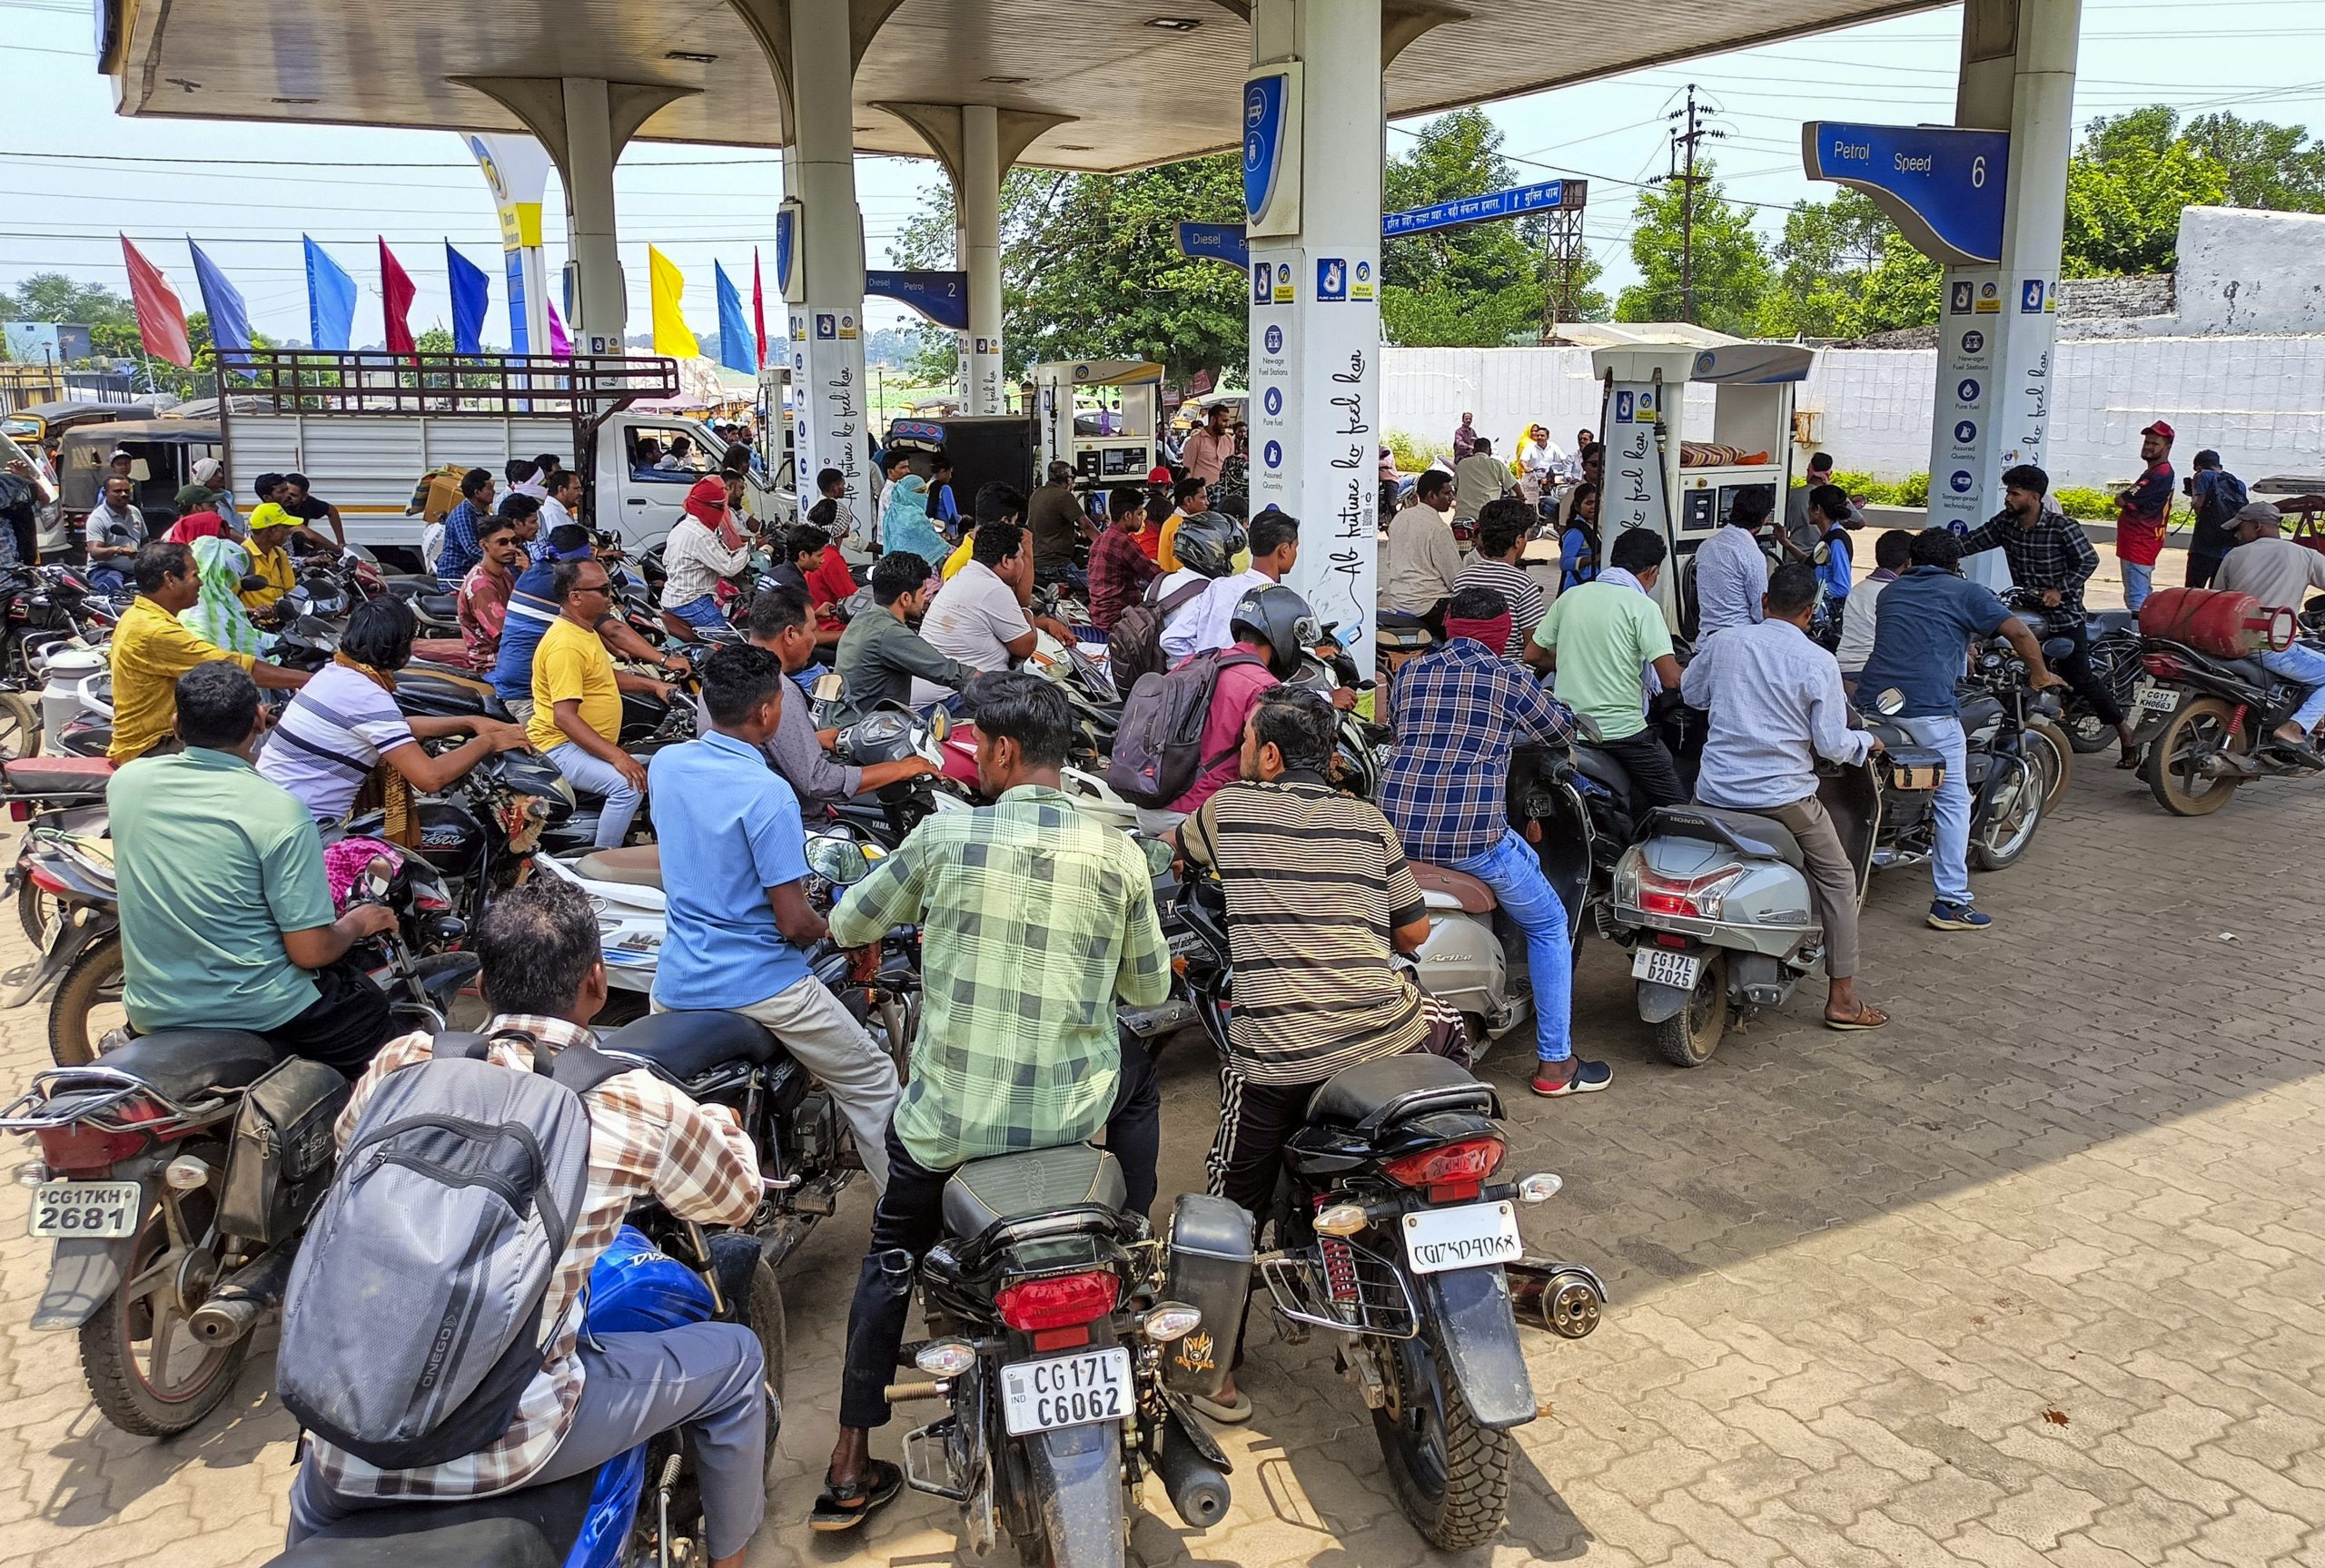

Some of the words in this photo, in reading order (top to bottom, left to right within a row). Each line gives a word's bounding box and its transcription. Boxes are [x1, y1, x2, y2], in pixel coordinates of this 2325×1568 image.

[1834, 140, 1870, 160] Petrol
[1894, 153, 1932, 174] Speed
[1972, 155, 1985, 189] 6
[1192, 232, 1222, 245] Diesel
[868, 278, 890, 288] Diesel
[904, 281, 925, 292] Petrol
[947, 282, 956, 298] 2
[1262, 357, 1284, 366] New-age
[1957, 355, 1985, 363] New-age
[1259, 368, 1269, 376] Fuel
[1270, 368, 1288, 376] Stations
[828, 391, 858, 417] feel
[1968, 402, 1980, 410] fuel
[2024, 385, 2047, 419] feel
[1262, 419, 1274, 427] Pure
[1274, 418, 1283, 427] fuel
[1331, 393, 1369, 435] feel
[832, 422, 856, 438] ko
[2022, 425, 2043, 445] ko
[837, 442, 861, 478] future
[1331, 444, 1364, 468] ko
[1951, 452, 1975, 461] Quantity
[1263, 471, 1282, 479] Assured
[1262, 481, 1283, 491] Quantity
[1621, 468, 1651, 503] feel
[1335, 478, 1362, 538] future
[1942, 493, 1978, 503] Tamper-proof
[1944, 502, 1975, 511] technology
[1330, 547, 1364, 575] Ab
[2139, 699, 2171, 710] KH0663
[2146, 690, 2170, 701] CG17
[1651, 951, 1692, 973] CG17L
[1647, 964, 1690, 987] D2025
[48, 1189, 122, 1205] CG17KH
[37, 1207, 126, 1230] 2681
[421, 1326, 453, 1388] ONEGO
[1034, 1356, 1117, 1395] CG17L
[1011, 1395, 1027, 1405] IND
[1037, 1386, 1121, 1426] C6062
